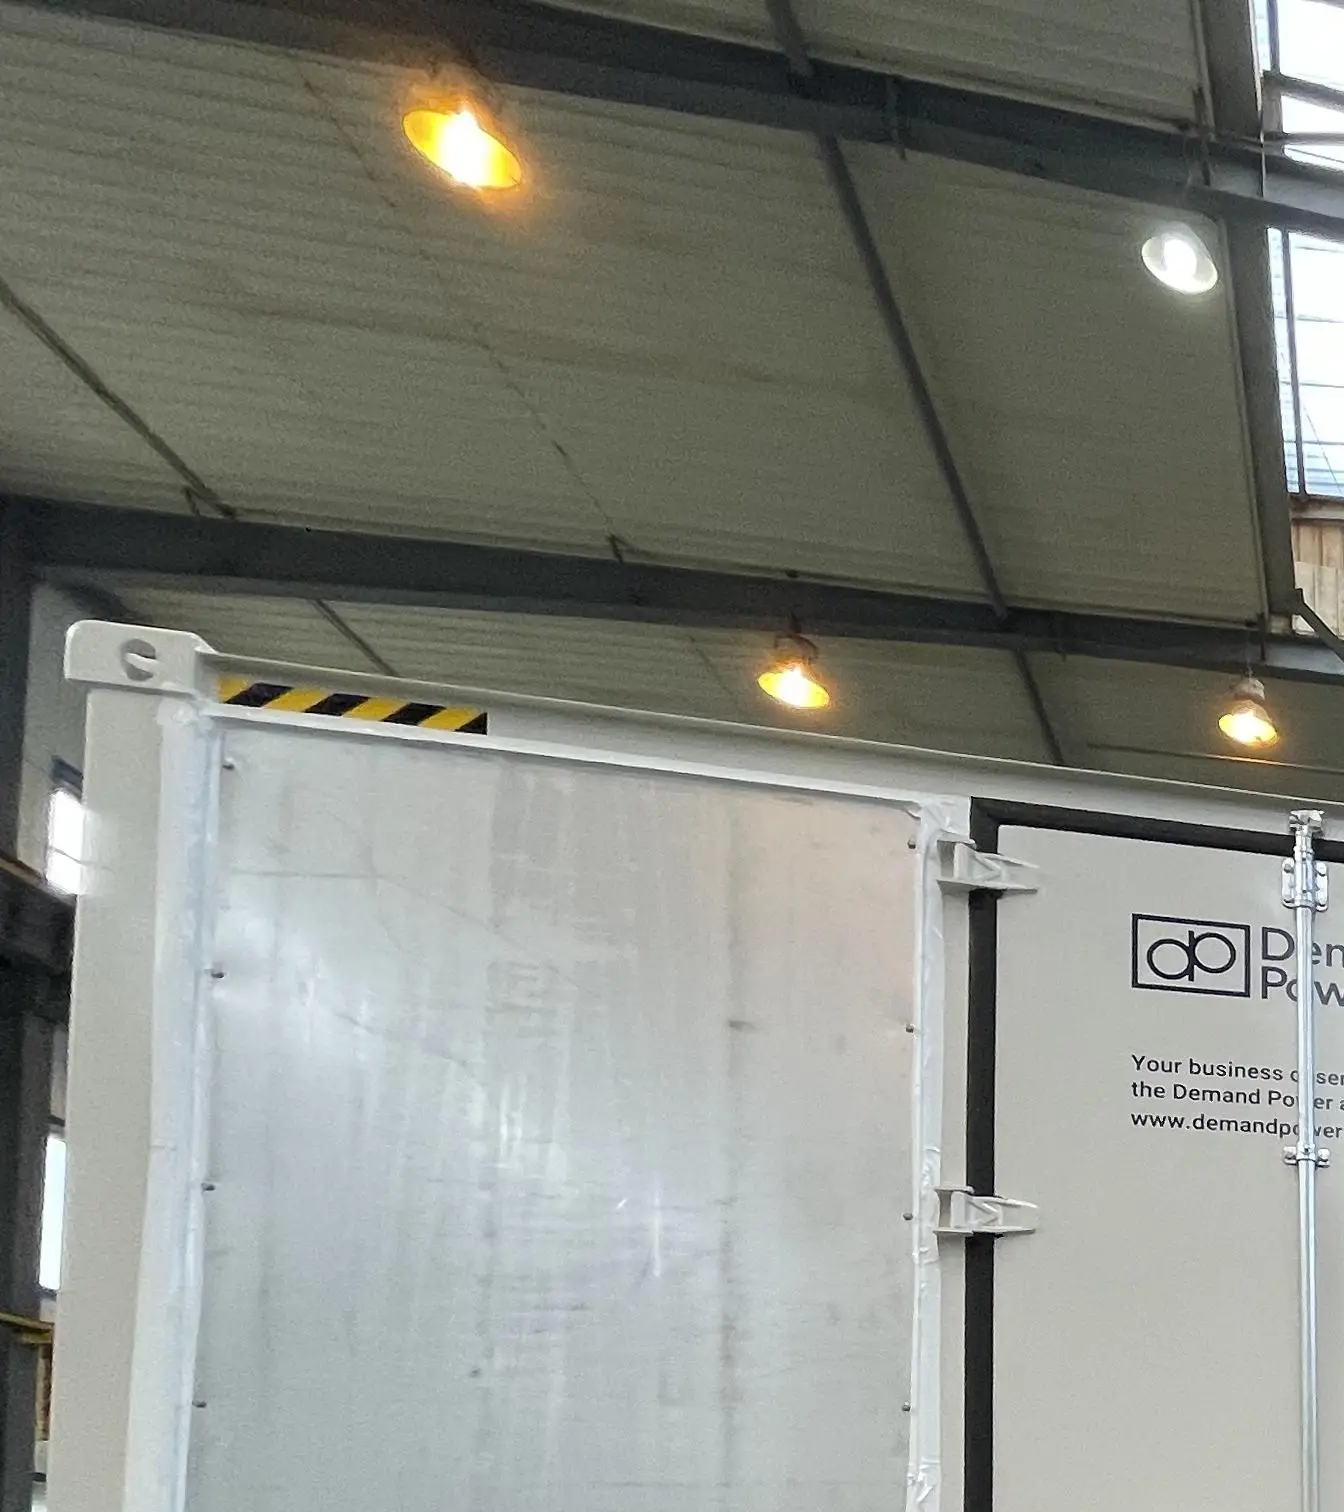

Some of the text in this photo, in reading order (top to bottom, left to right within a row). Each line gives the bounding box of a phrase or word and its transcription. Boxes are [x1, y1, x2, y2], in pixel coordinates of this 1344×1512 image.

[1131, 1054, 1182, 1075] Your
[1189, 1058, 1283, 1082] business
[1131, 1081, 1165, 1099] the
[1173, 1083, 1260, 1105] Demand
[1268, 1090, 1333, 1111] Poer
